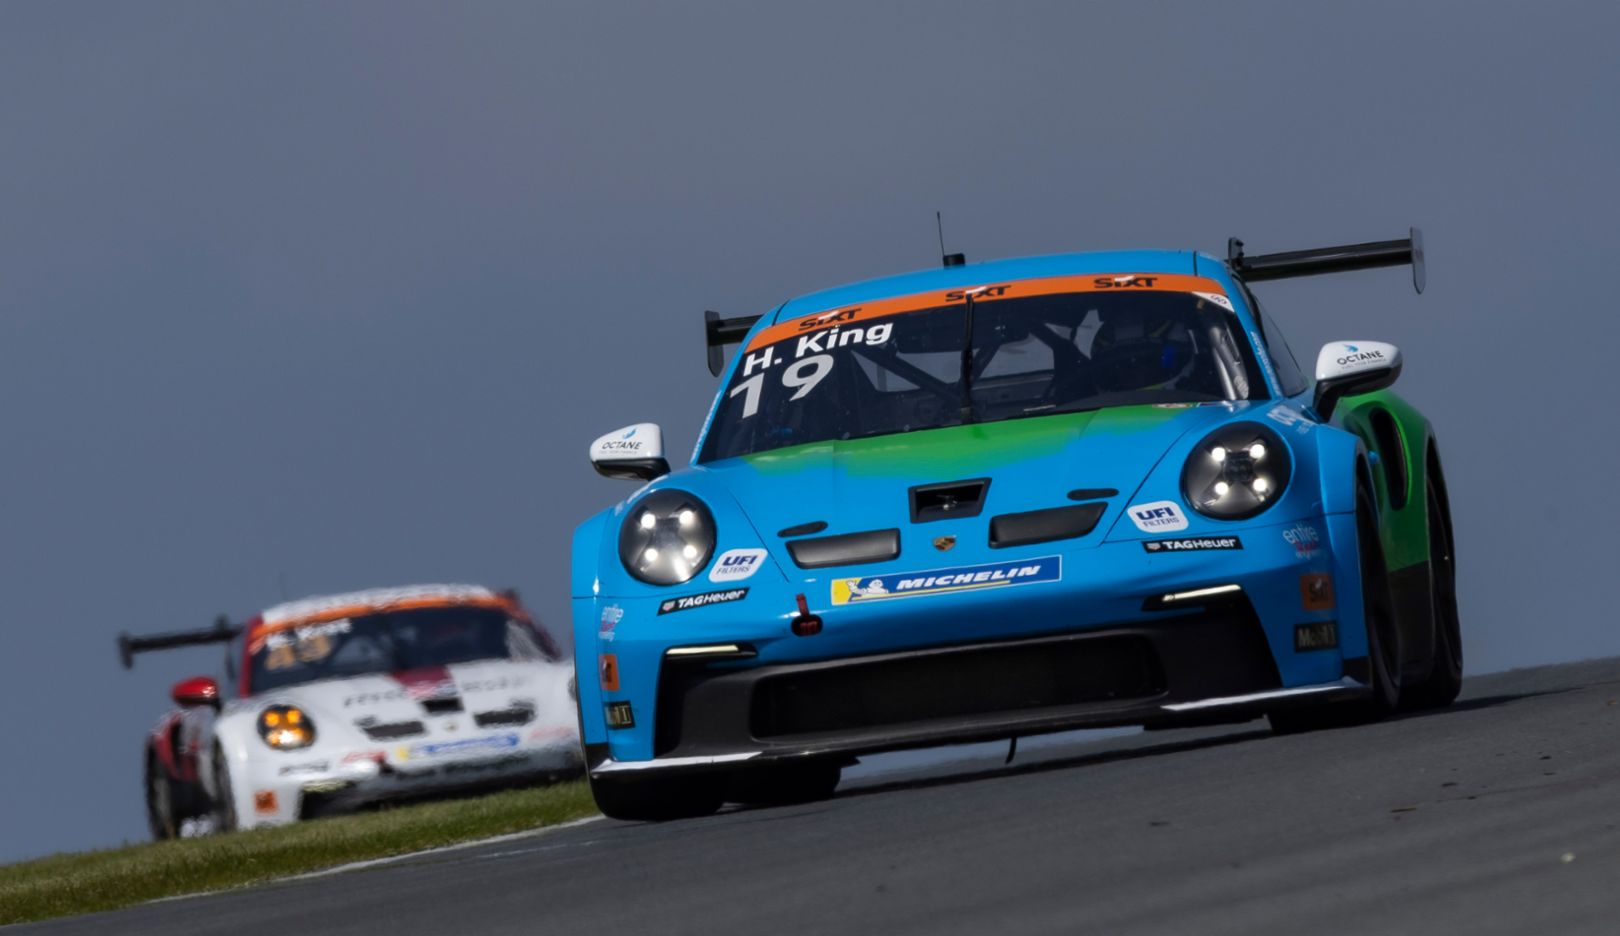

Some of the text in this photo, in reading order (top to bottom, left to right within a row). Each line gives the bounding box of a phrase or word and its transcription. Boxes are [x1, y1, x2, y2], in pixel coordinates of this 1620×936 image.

[743, 323, 894, 377] H. King
[1336, 350, 1385, 366] OCTANE
[729, 353, 835, 419] 19
[601, 441, 643, 450] OCTANE
[1136, 507, 1176, 521] UFI
[1142, 516, 1180, 528] FILTERS
[722, 555, 759, 567] UFI
[716, 565, 751, 575] FILTERS
[896, 565, 1042, 591] MICHELIN
